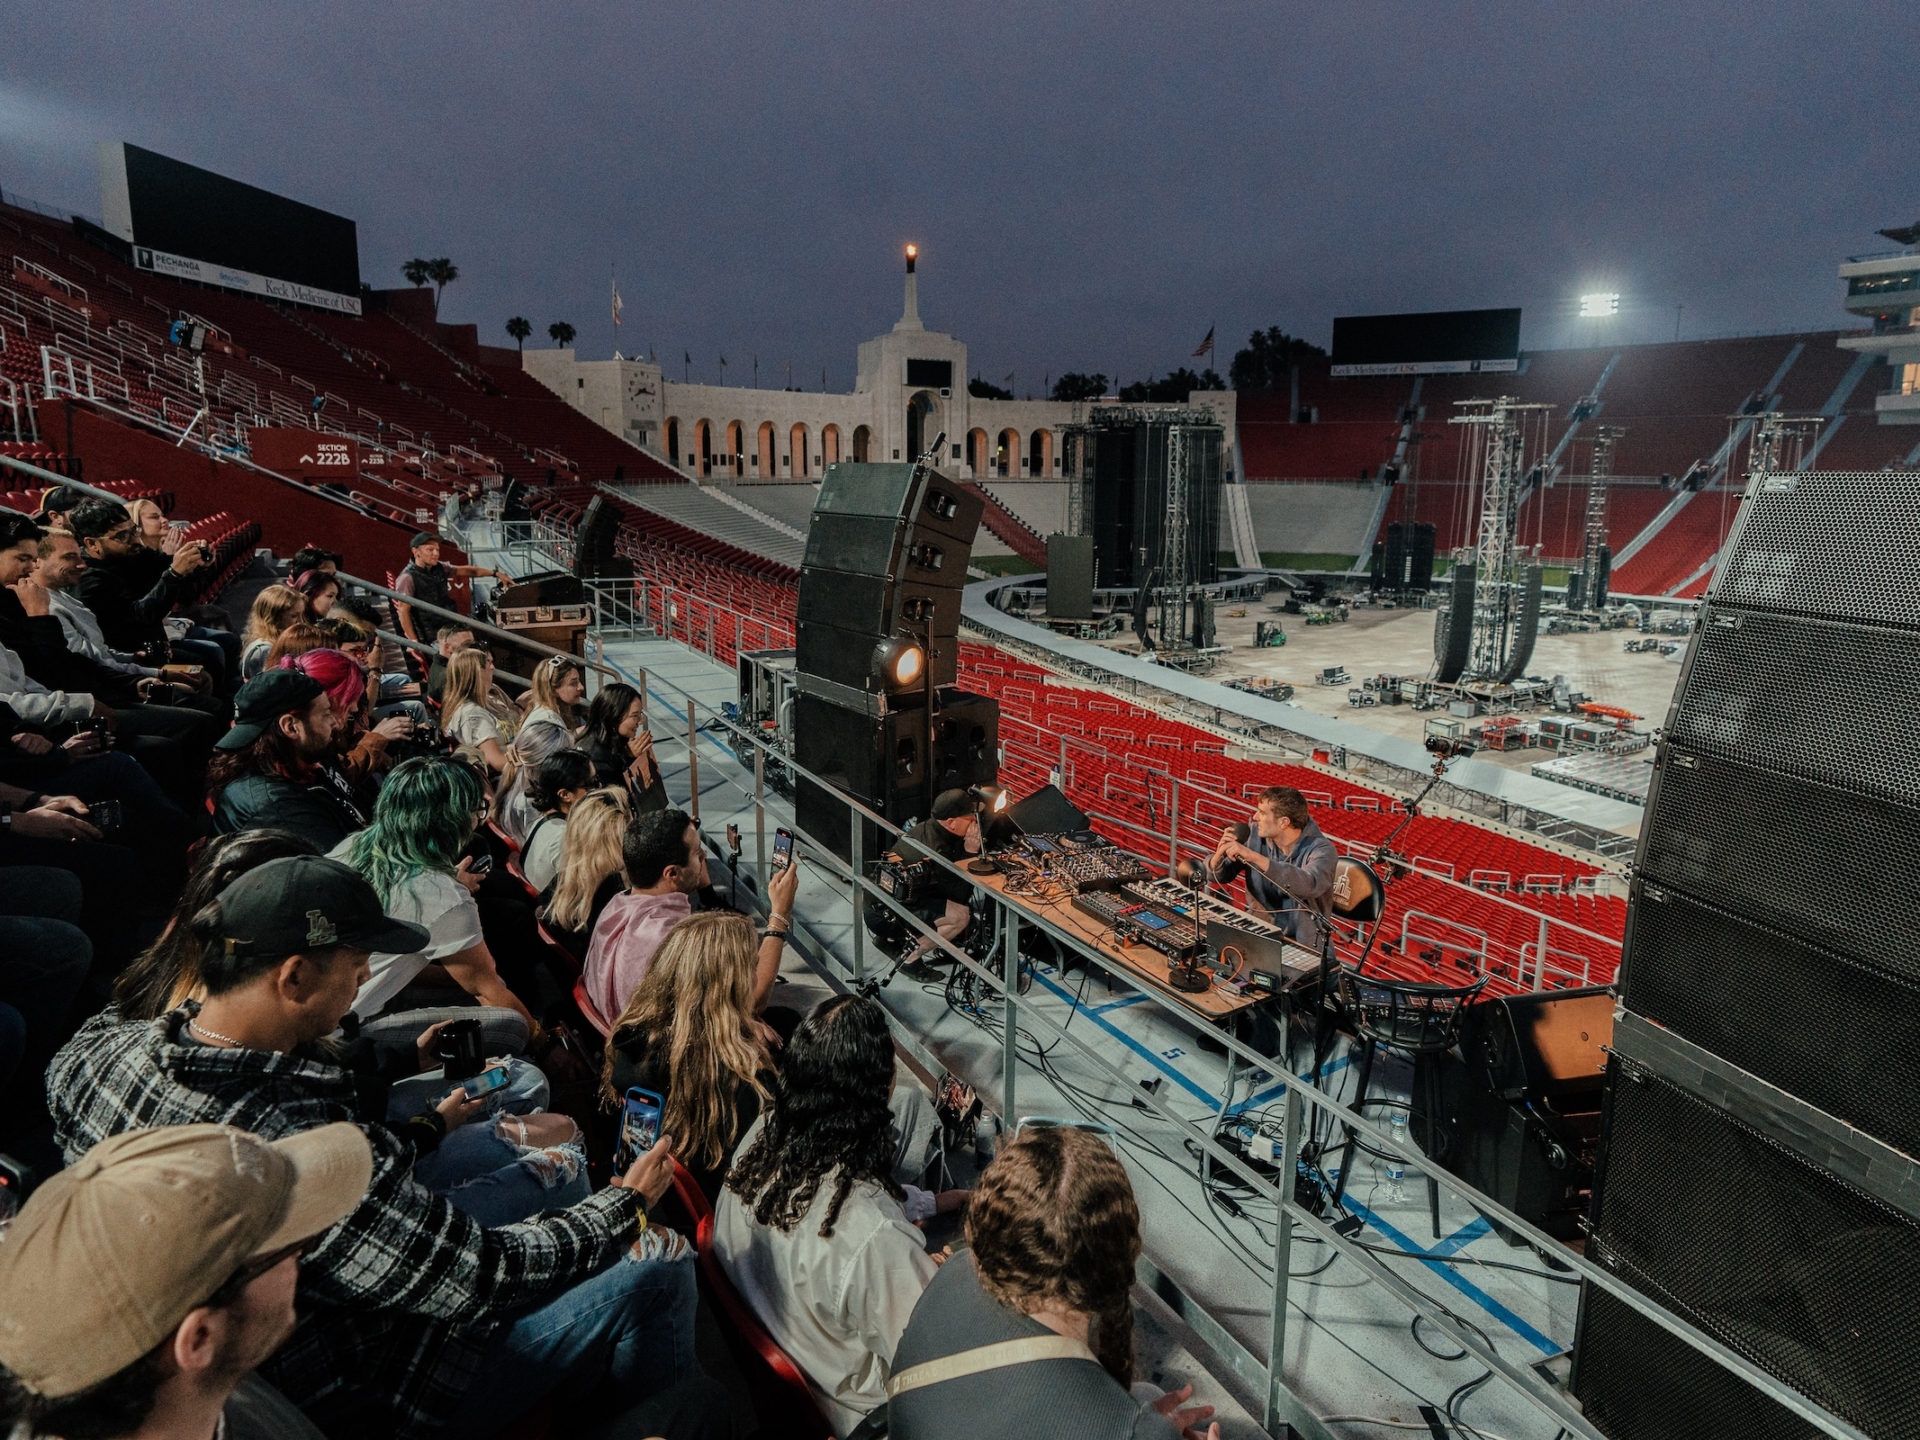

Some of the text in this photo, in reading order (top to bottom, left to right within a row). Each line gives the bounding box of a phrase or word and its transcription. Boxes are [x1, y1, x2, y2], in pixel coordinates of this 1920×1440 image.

[155, 254, 200, 271] PECHANGA
[265, 279, 289, 298] Keck
[291, 285, 330, 306] Medicine
[331, 295, 340, 308] of
[341, 297, 359, 312] USC
[317, 444, 348, 452] SECTION
[316, 453, 351, 465] 222B
[305, 909, 338, 947] LA
[901, 1368, 939, 1387] THREAD
